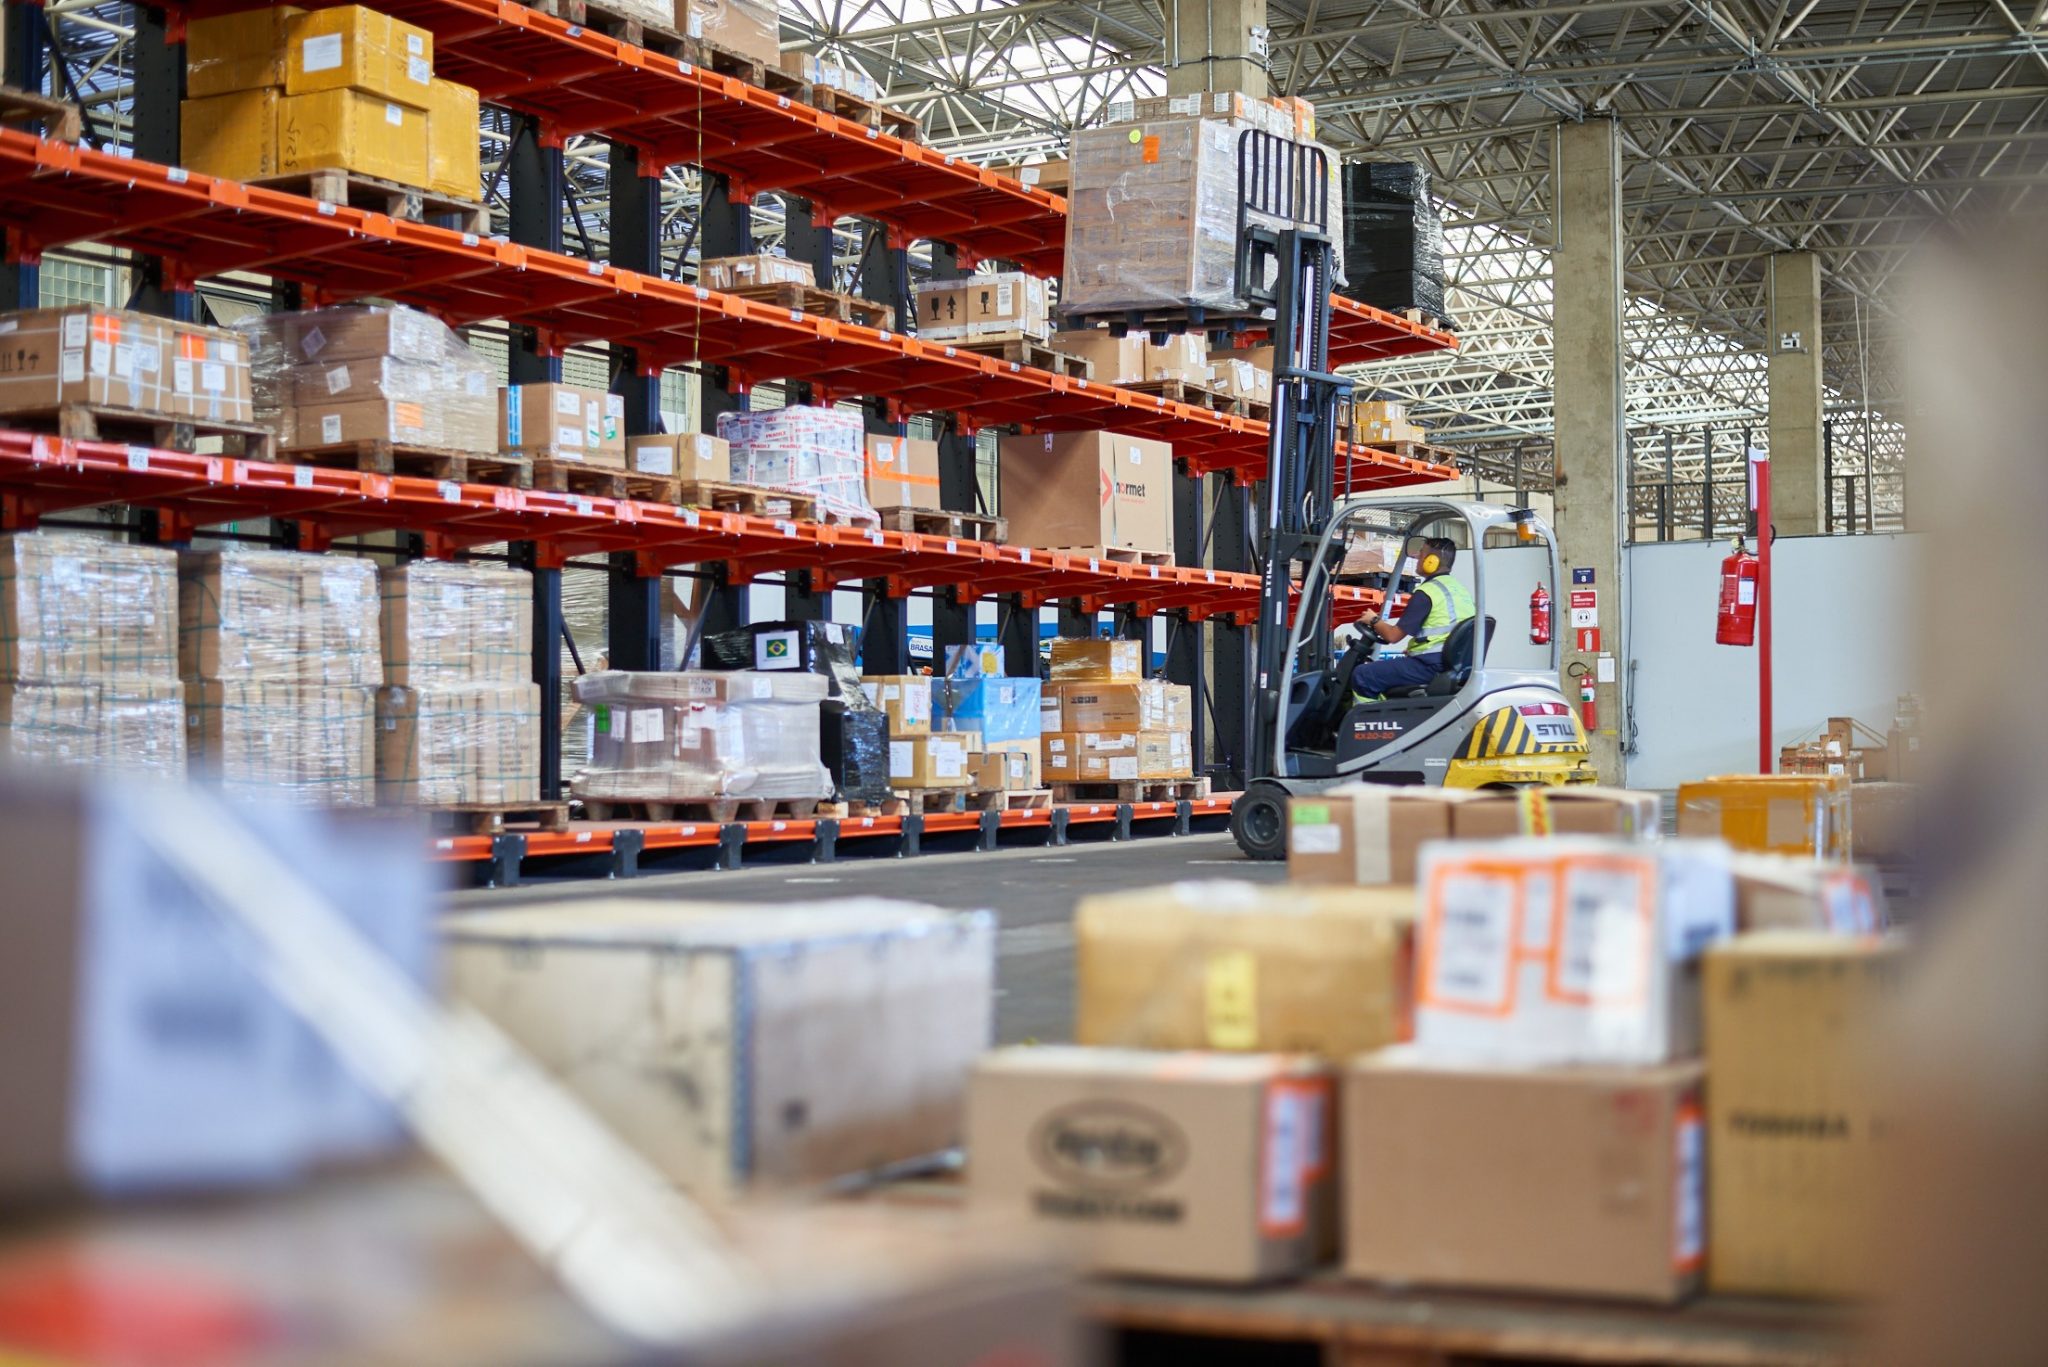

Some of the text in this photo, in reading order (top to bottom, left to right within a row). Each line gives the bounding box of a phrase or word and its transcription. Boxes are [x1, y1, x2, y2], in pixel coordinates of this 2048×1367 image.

[1116, 482, 1145, 497] normet
[1265, 559, 1273, 597] STILL
[1354, 721, 1403, 731] STILL
[1537, 724, 1575, 736] STILL
